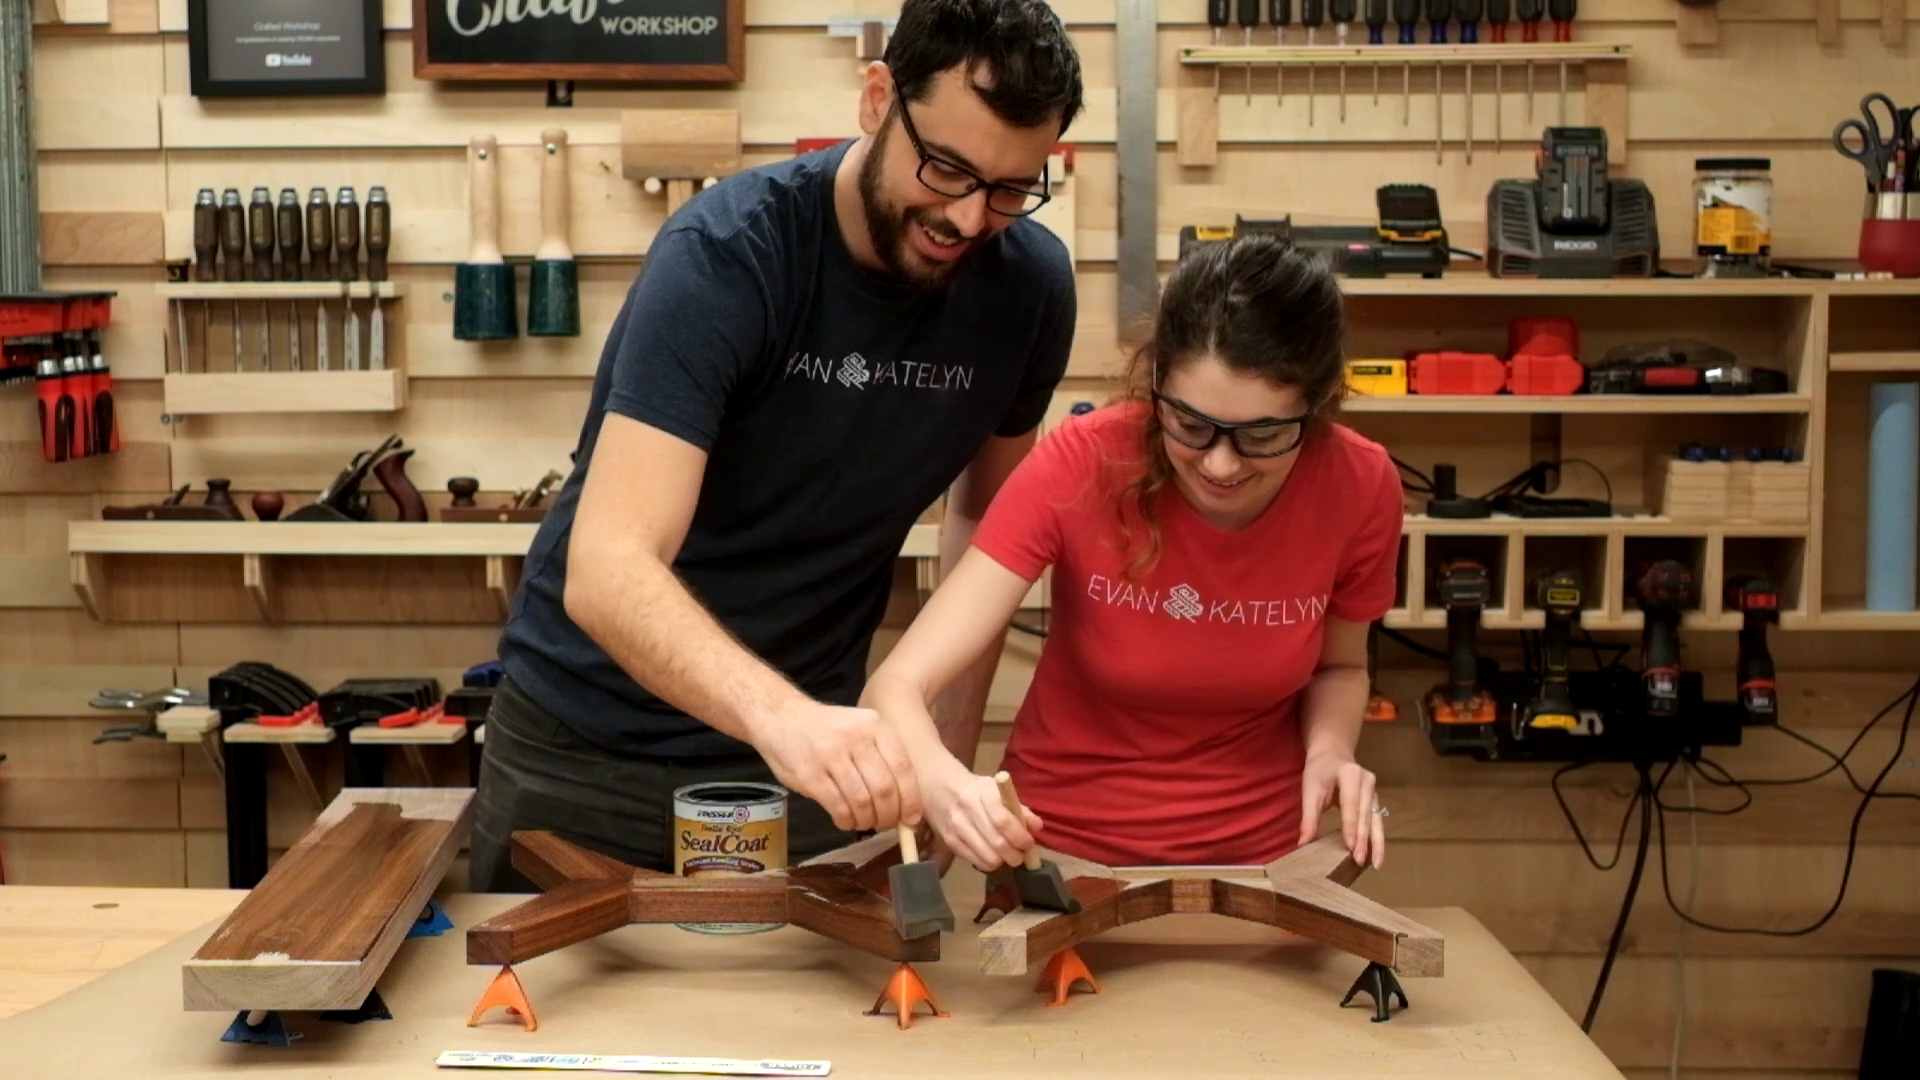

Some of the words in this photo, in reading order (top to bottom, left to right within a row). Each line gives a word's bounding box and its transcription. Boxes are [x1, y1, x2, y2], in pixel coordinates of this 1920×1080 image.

[600, 16, 719, 35] WORKSHOP
[1553, 240, 1598, 250] RIDGID
[1087, 574, 1159, 614] EVAN
[1208, 593, 1328, 626] KATELYN
[680, 830, 770, 854] SealCoat
